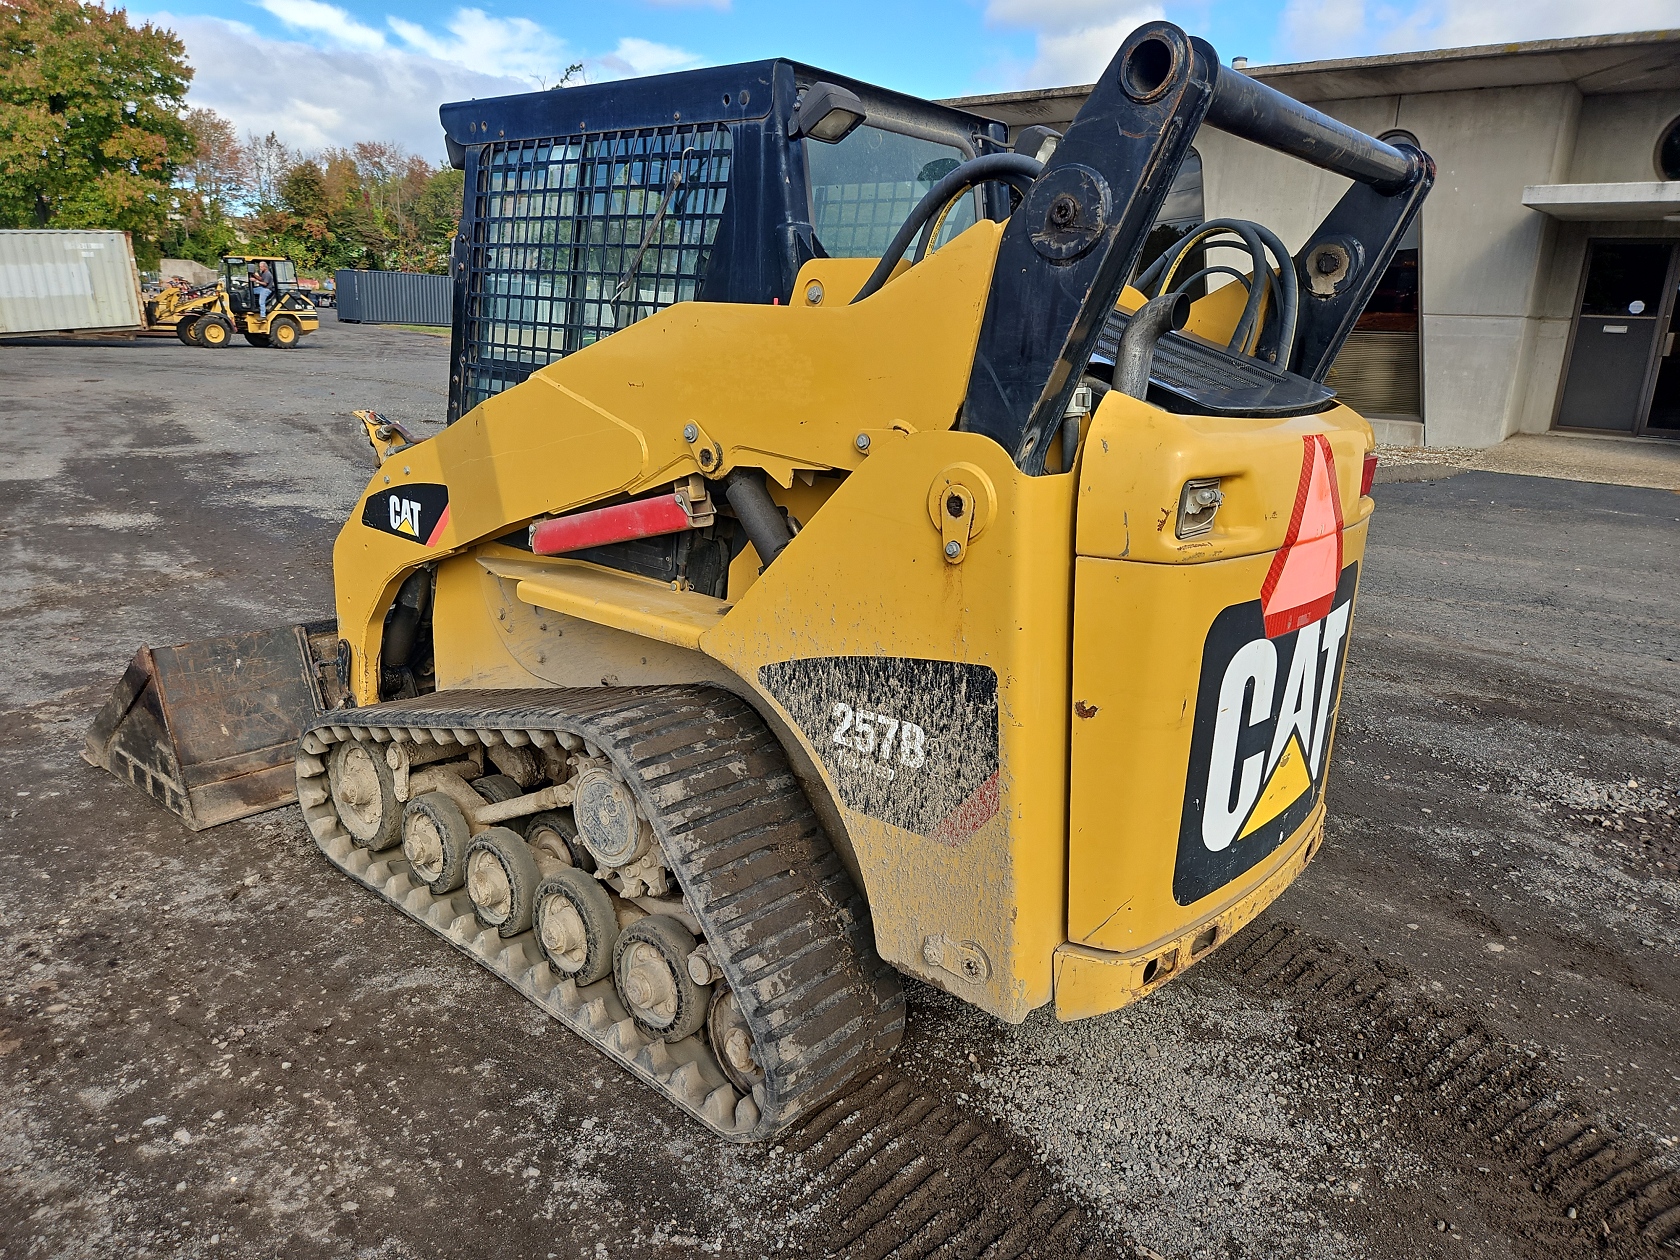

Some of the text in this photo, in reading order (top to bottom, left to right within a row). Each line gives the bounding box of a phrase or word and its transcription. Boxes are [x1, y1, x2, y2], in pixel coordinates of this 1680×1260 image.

[389, 495, 421, 537] CAT
[832, 702, 925, 769] 257B
[1202, 600, 1350, 852] CAT
